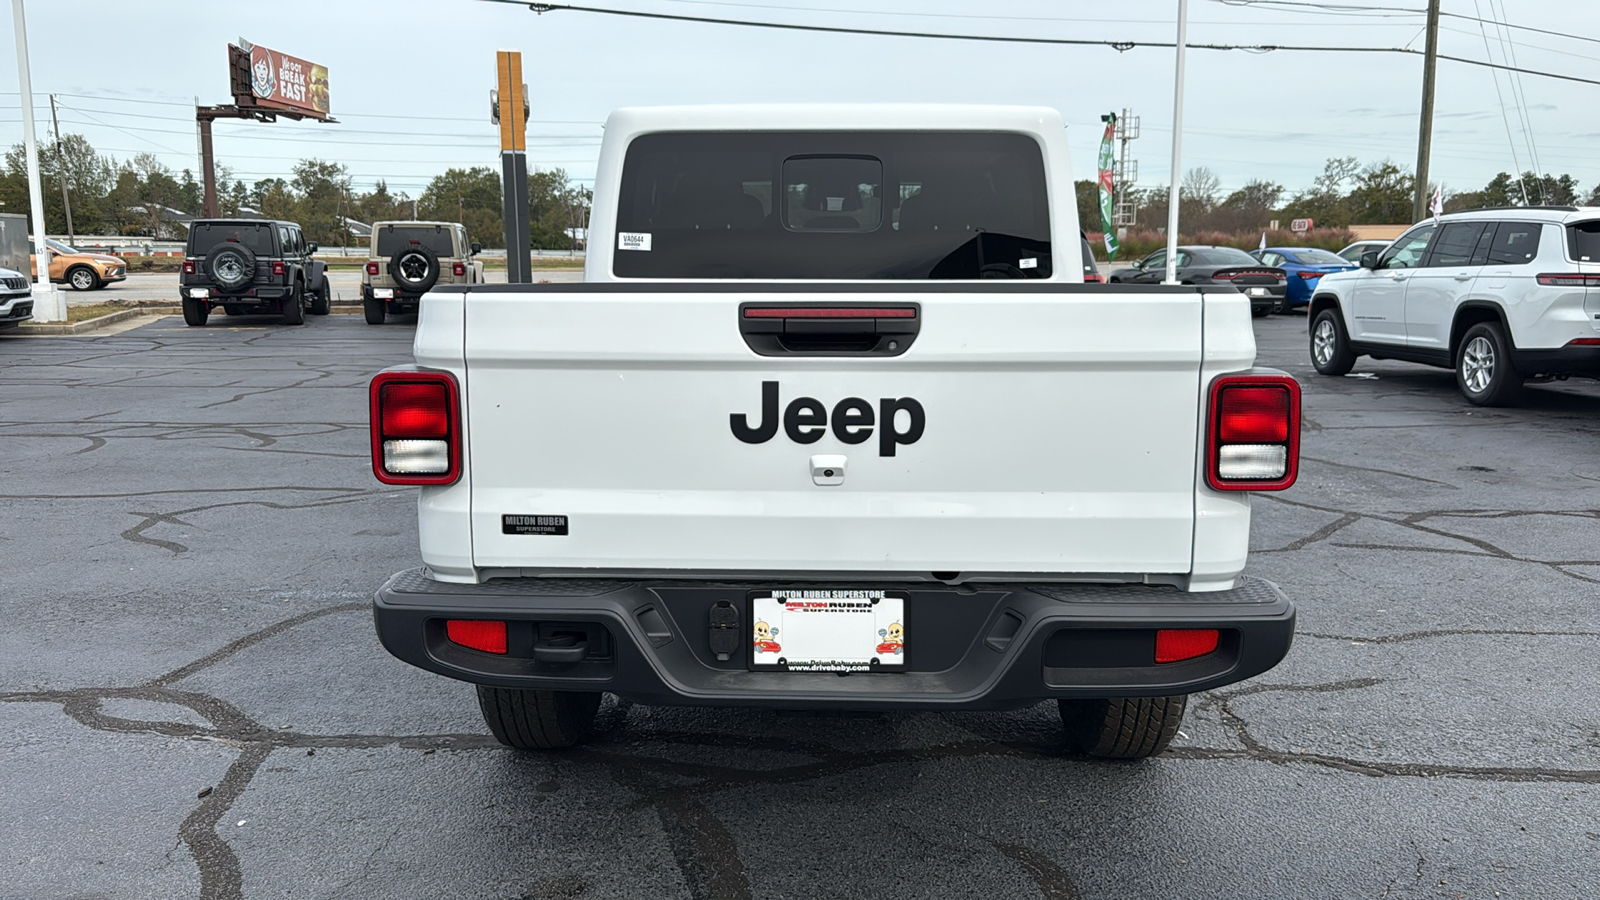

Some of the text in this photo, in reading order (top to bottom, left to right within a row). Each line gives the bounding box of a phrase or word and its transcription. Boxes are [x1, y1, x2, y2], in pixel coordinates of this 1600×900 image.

[279, 67, 305, 86] BREAK
[279, 80, 306, 102] FAST
[730, 381, 926, 457] Jeep
[505, 516, 565, 526] MILTON RUBEN
[771, 590, 885, 599] MILTON RUBEN SUPERSTORE
